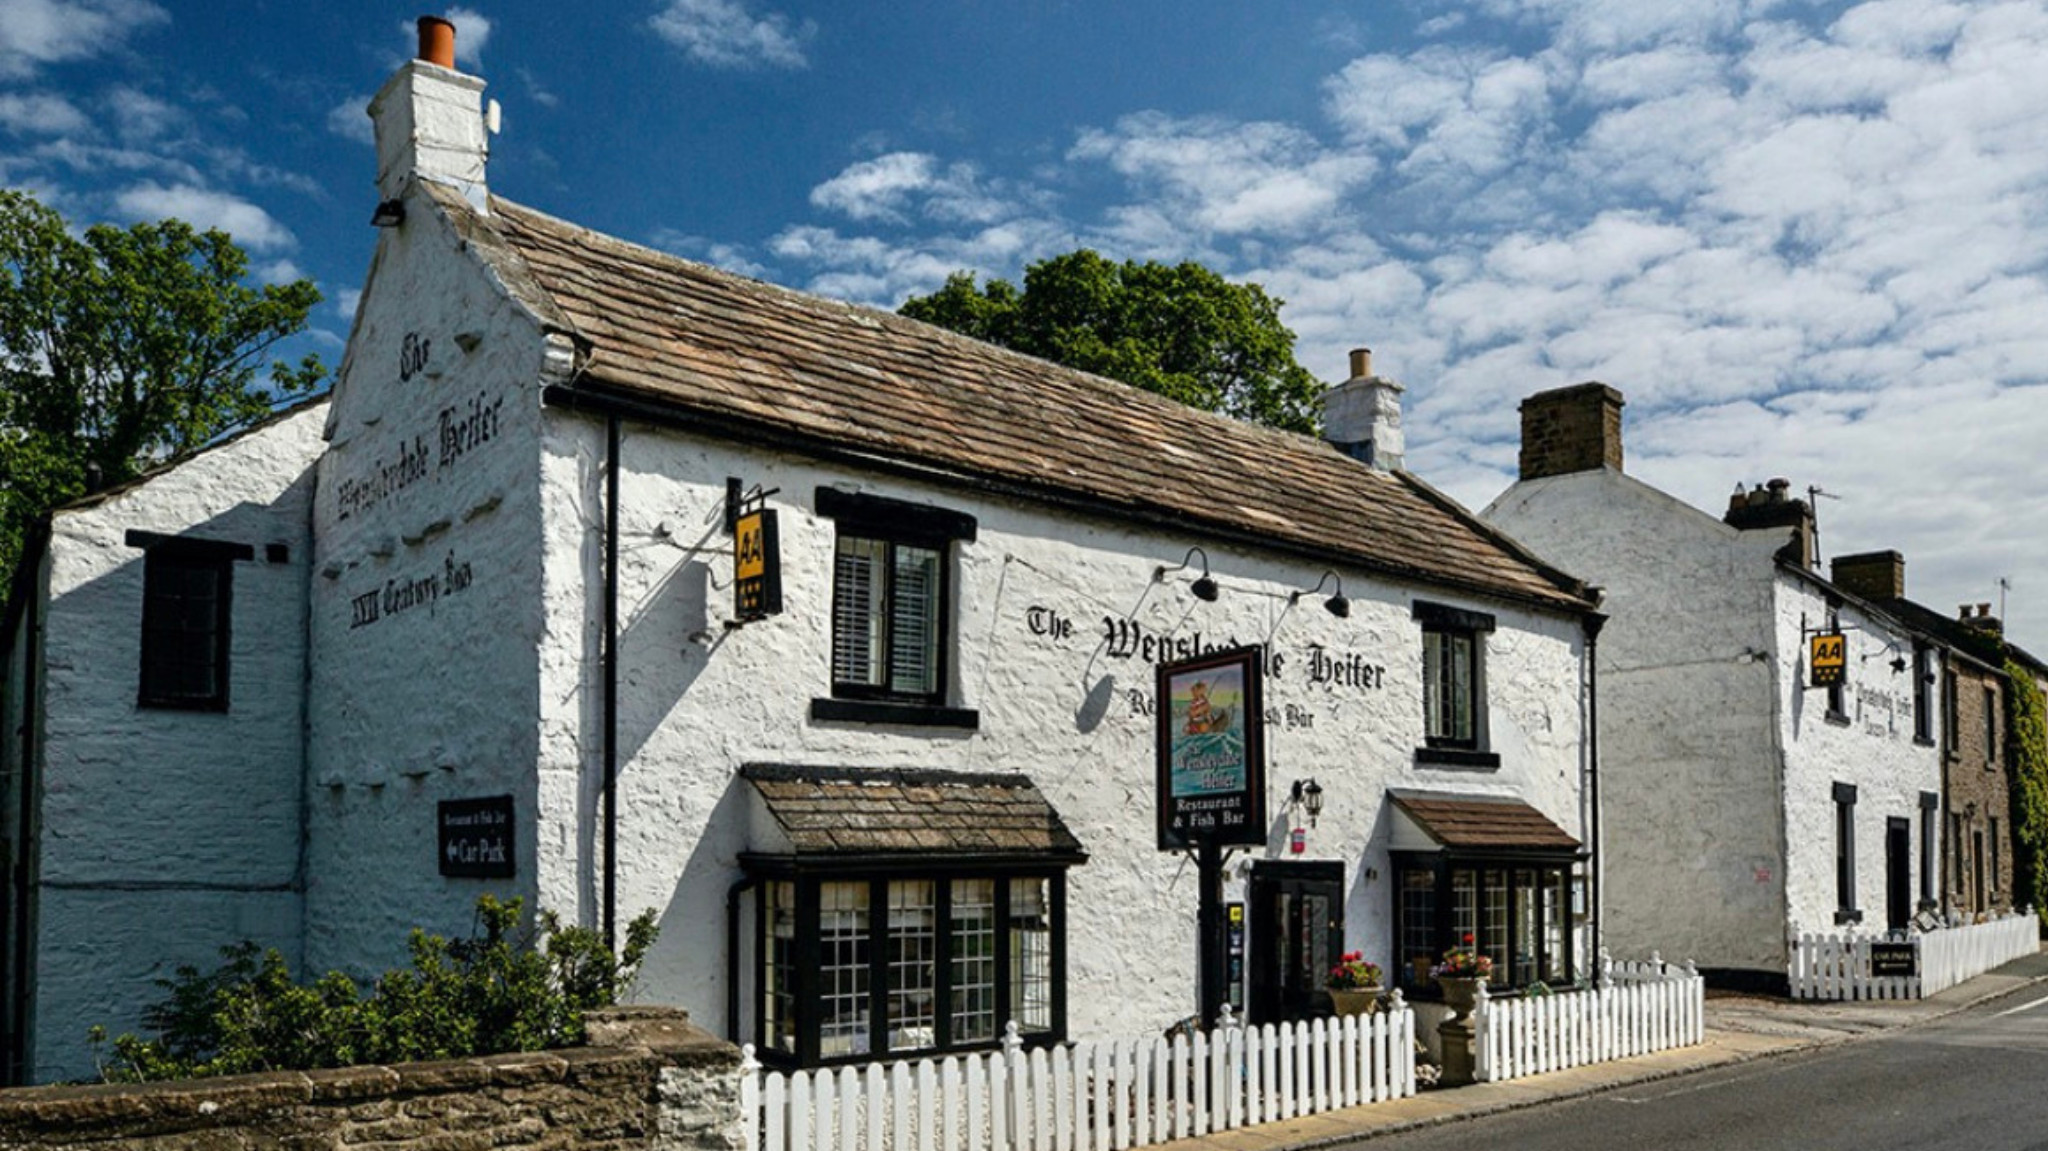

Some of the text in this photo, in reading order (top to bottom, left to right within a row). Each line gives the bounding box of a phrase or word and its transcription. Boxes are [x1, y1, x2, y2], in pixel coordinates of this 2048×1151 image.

[400, 331, 431, 382] The
[438, 390, 503, 470] Heifer
[739, 528, 762, 565] AA
[1025, 605, 1073, 641] The
[1306, 642, 1386, 693] Heifer
[1815, 642, 1841, 660] AA
[1285, 703, 1315, 731] Bar
[1176, 797, 1241, 811] Restaurant
[1173, 810, 1244, 829] & Fish Bar
[459, 838, 506, 863] Car Park
